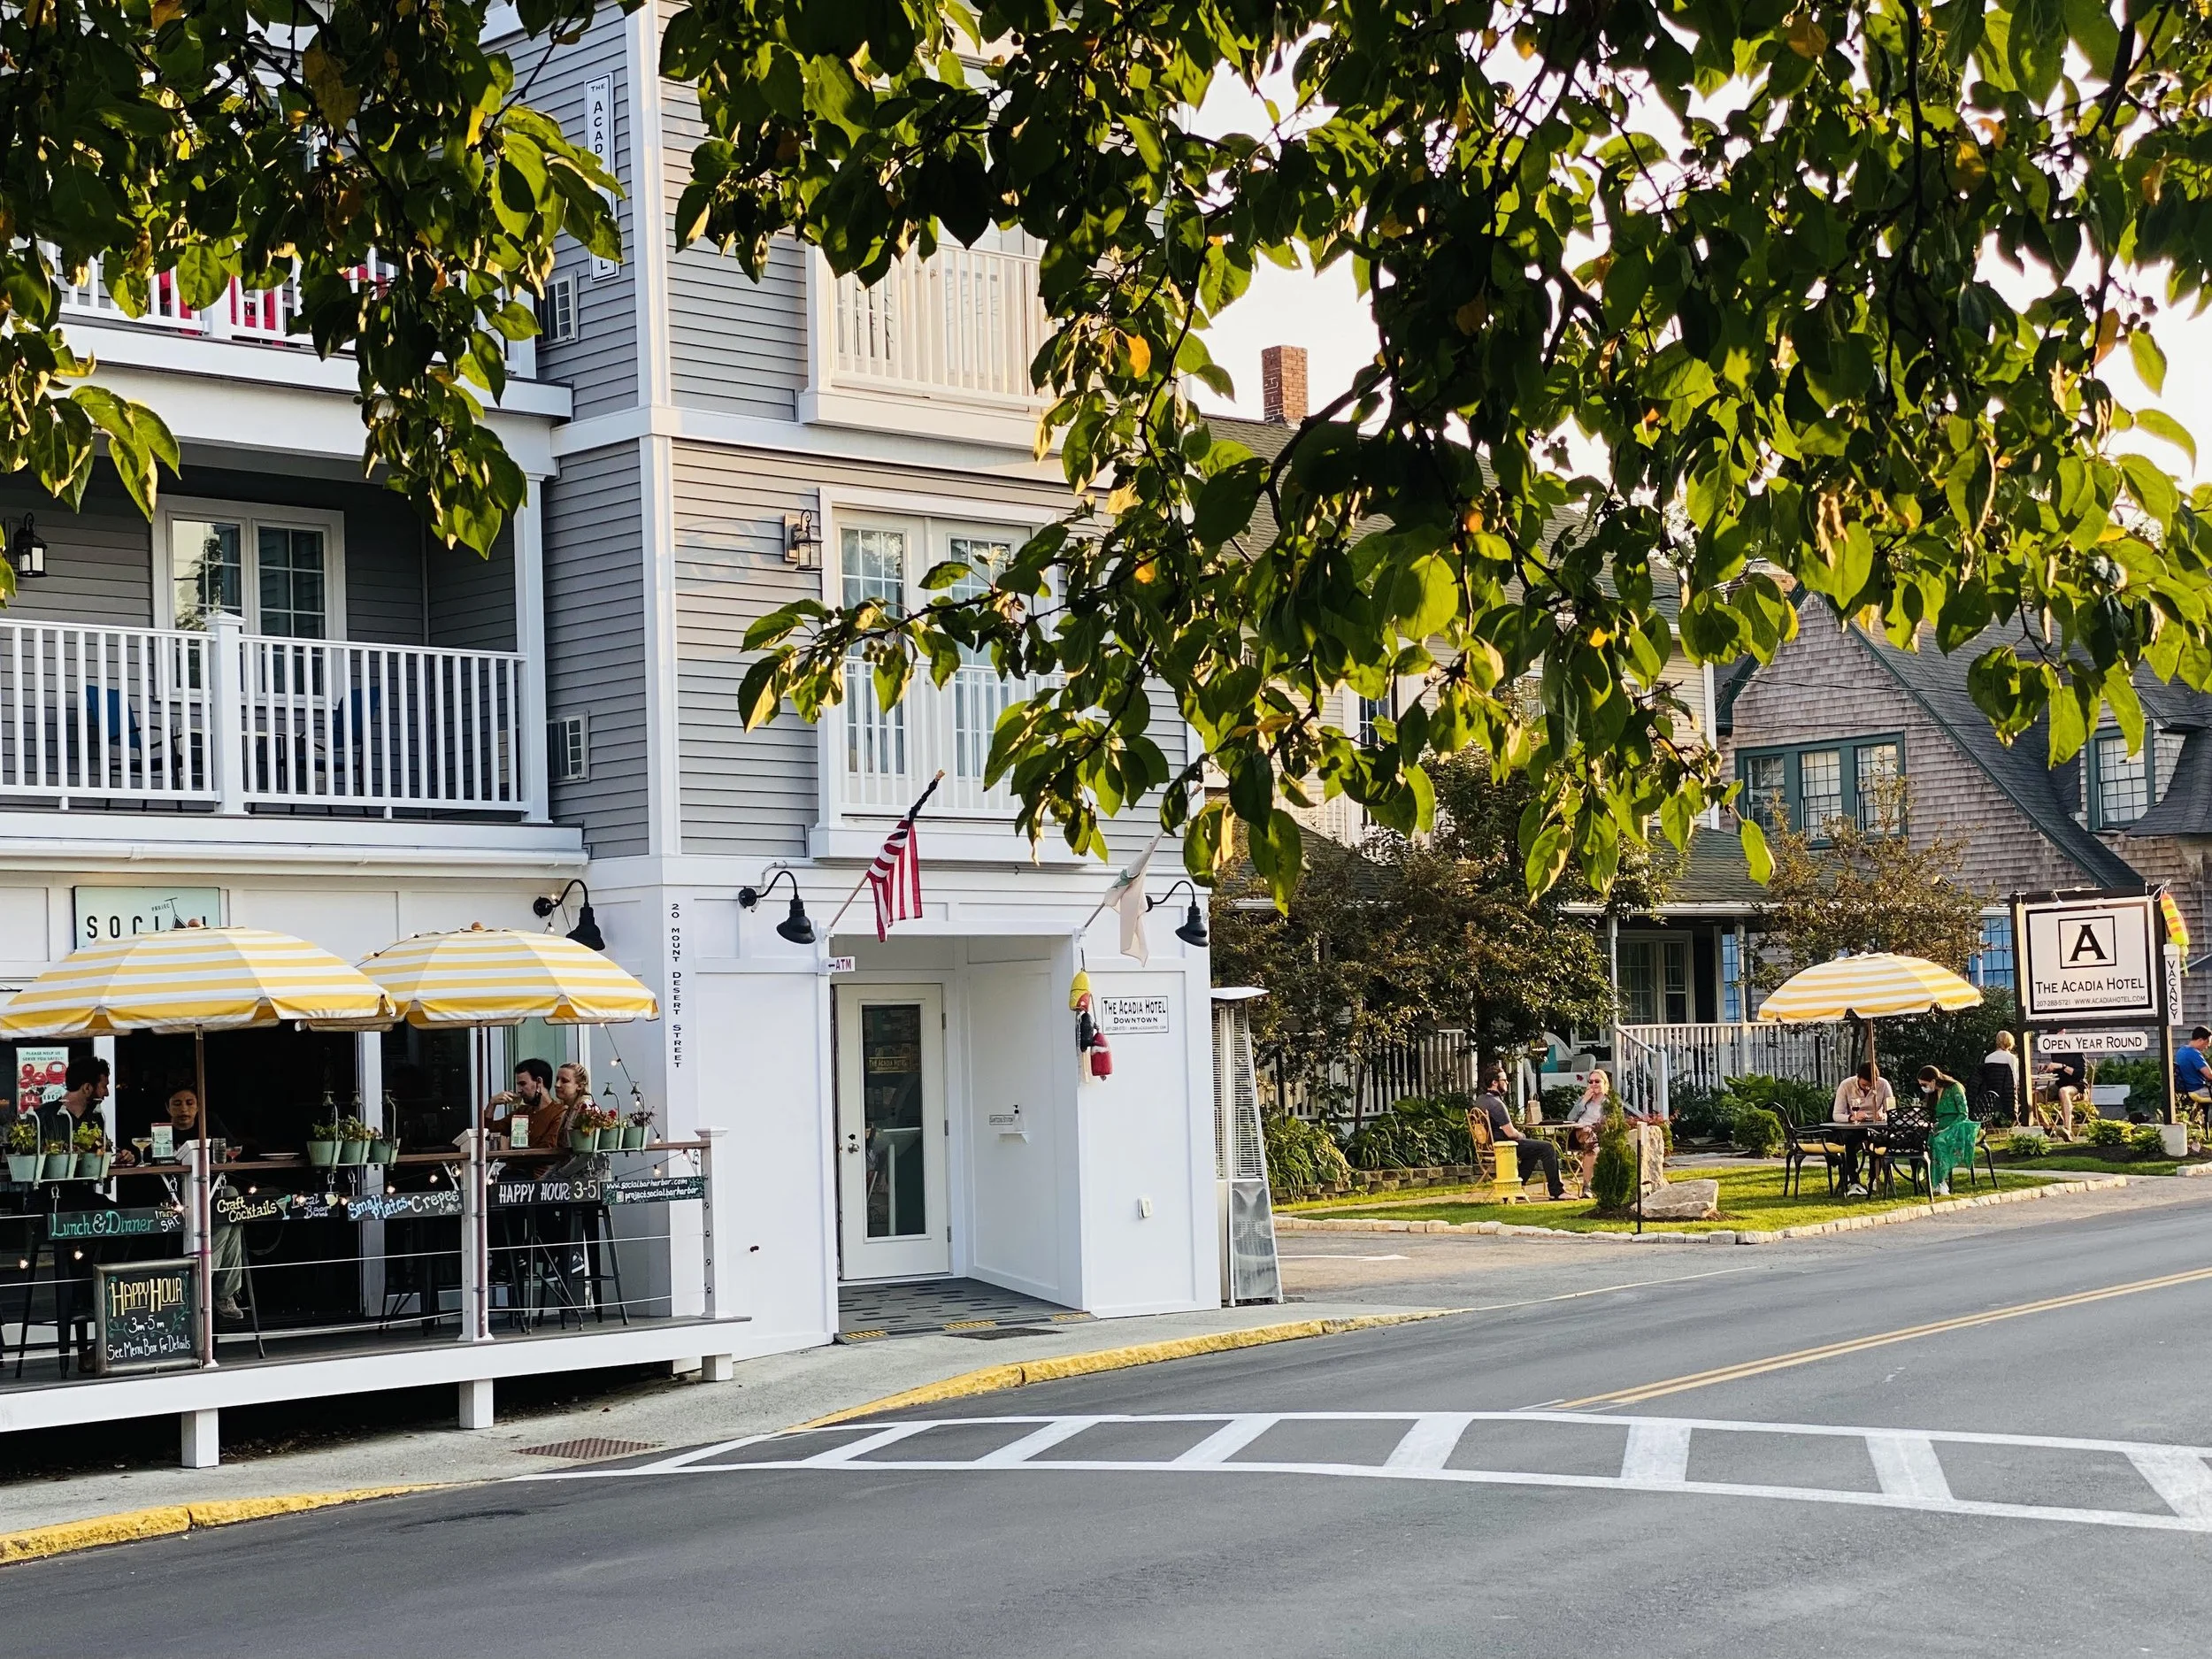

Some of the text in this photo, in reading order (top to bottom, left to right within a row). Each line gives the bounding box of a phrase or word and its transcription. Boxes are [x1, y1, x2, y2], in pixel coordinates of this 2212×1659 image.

[590, 83, 605, 92] THE
[671, 927, 680, 963] MOUNT
[2069, 924, 2108, 962] A
[835, 958, 852, 971] ATM
[672, 972, 681, 1016] DESERT
[2036, 977, 2145, 995] THE ACADIA HOTEL
[2167, 960, 2178, 1019] VACANCY
[1103, 998, 1166, 1015] THE ACADIA HOTEL
[2074, 995, 2146, 1005] WWW.ACADIAHOTEL.COM
[672, 1024, 681, 1068] STREET
[2042, 1036, 2142, 1050] OPEN YEAR ROUND
[498, 1184, 535, 1204] HAPPY
[573, 1179, 598, 1200] 3-5
[606, 1178, 688, 1190] www.socialbarharbor.com
[217, 1195, 246, 1213] Craft
[228, 1200, 277, 1223] Cocktails
[303, 1205, 332, 1219] Beer
[348, 1194, 383, 1219] Small
[372, 1190, 460, 1220] Plates Crepes
[51, 1213, 91, 1237] Lunch
[105, 1210, 155, 1234] Dinner
[160, 1215, 180, 1233] SAT
[111, 1277, 184, 1317] HAPPY HOUR
[107, 1344, 124, 1361] See
[123, 1341, 143, 1358] Menu
[142, 1338, 157, 1356] Box
[166, 1334, 191, 1354] Details
